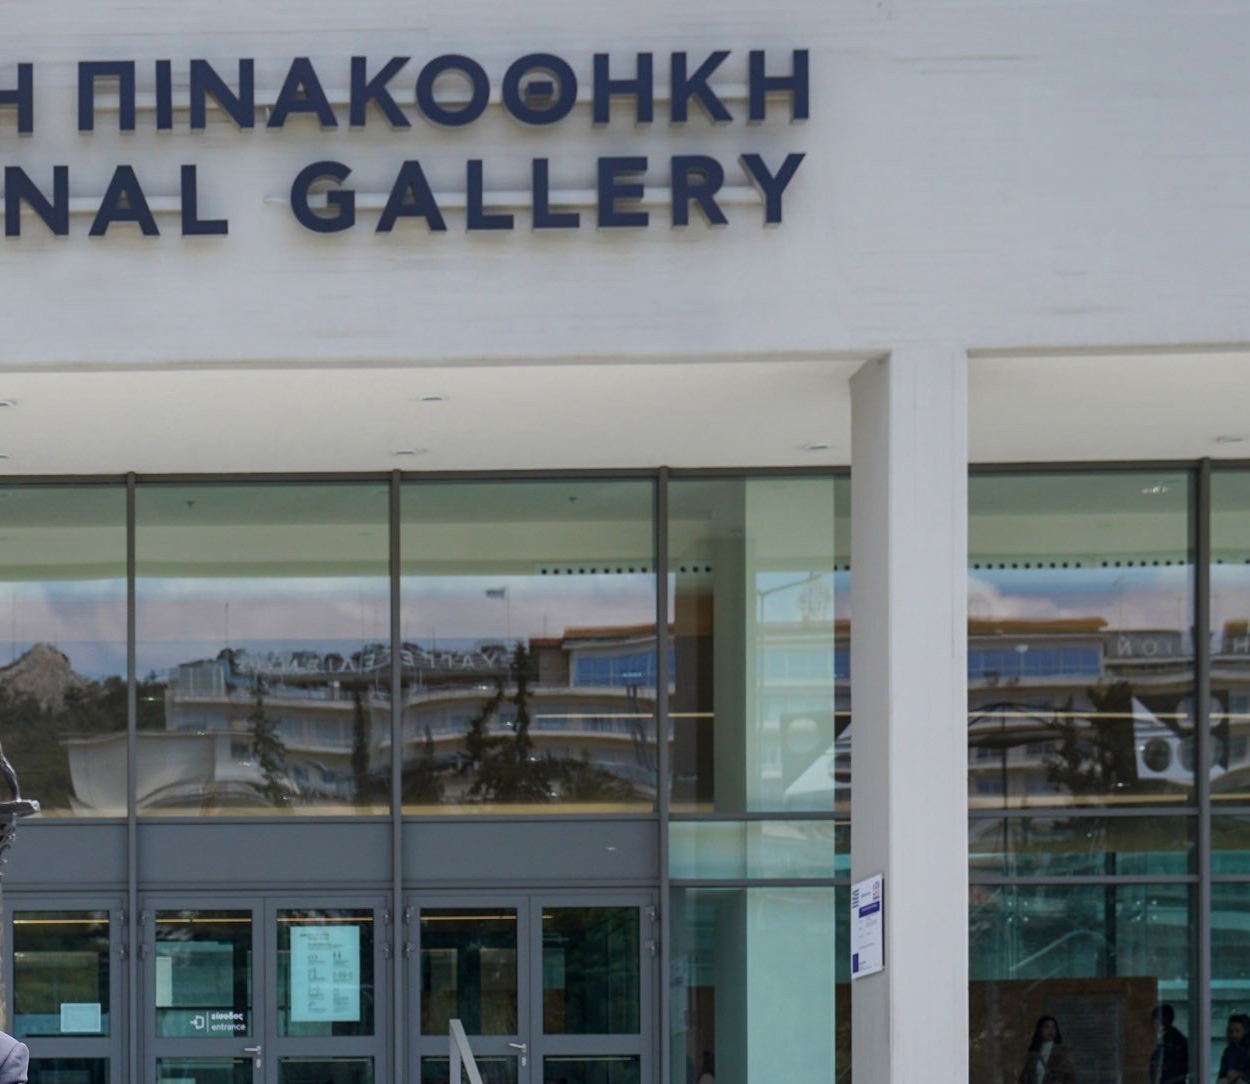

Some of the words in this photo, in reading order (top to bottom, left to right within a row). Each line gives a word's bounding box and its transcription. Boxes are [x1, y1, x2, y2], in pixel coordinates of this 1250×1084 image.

[77, 48, 810, 132] ΠΙΝΑΚΟΘΗΚΗ
[290, 152, 807, 234] GALLERY
[211, 1023, 246, 1031] entrance
